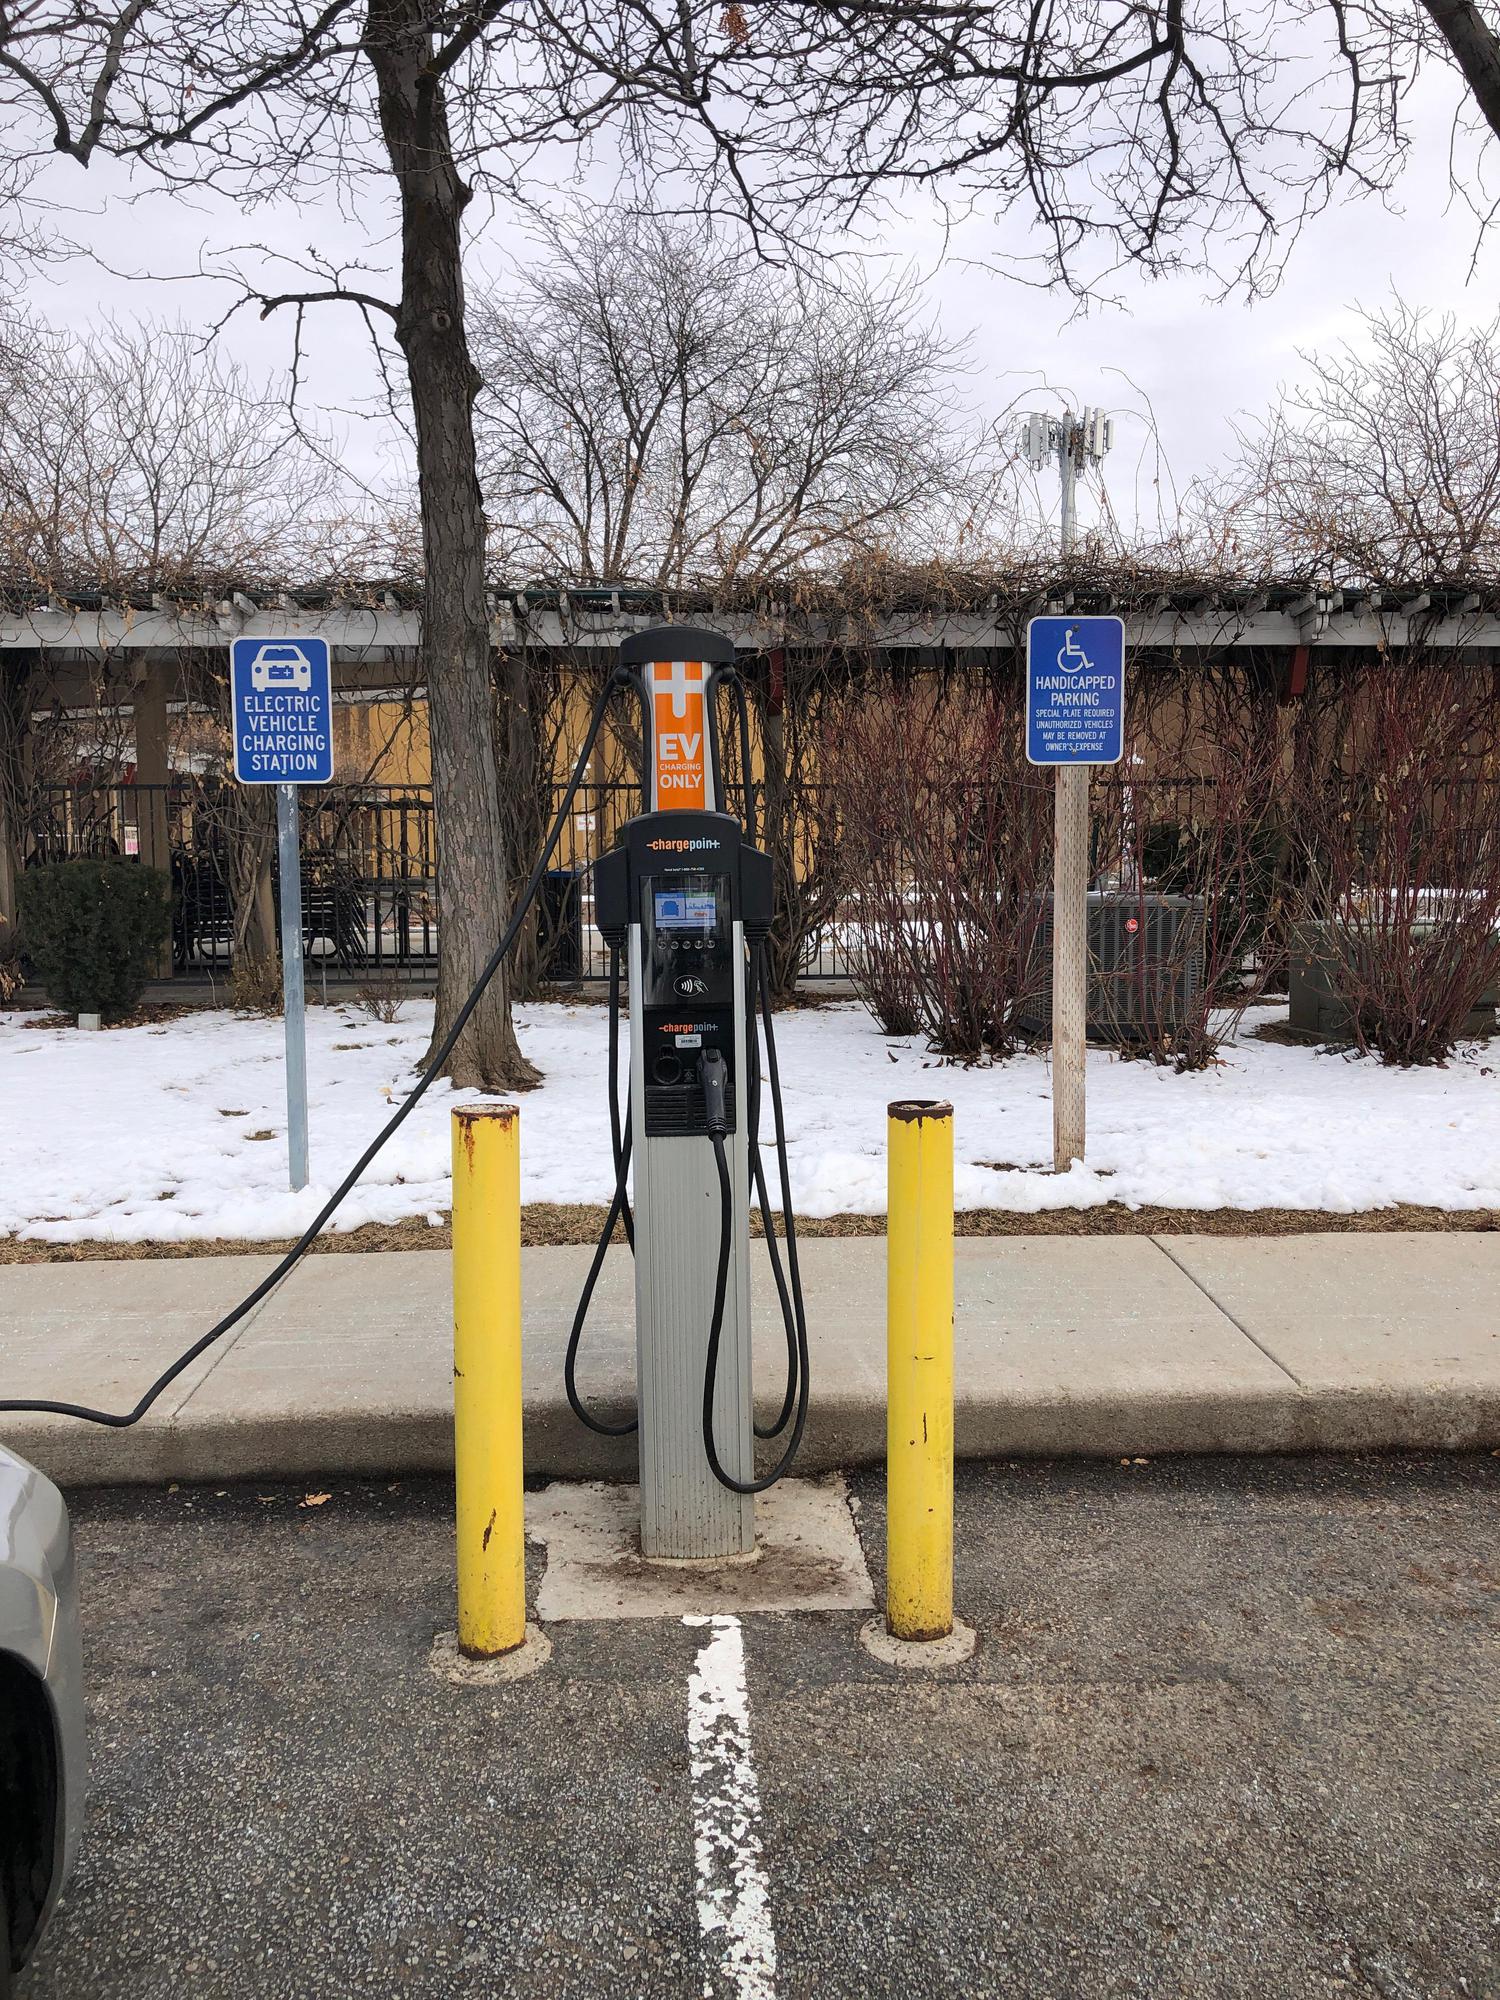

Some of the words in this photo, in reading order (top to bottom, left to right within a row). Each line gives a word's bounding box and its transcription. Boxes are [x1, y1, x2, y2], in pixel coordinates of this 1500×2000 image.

[1036, 675, 1115, 690] HANDICAPPED
[244, 696, 321, 713] ELECTRIC
[1051, 692, 1100, 706] PARKING
[1035, 708, 1061, 718] SPECIAL
[1062, 708, 1081, 718] PLATE
[1083, 708, 1115, 718] REQUIRED
[248, 715, 318, 732] VEHICLE
[1036, 720, 1082, 729] UNAUTHORIZED
[1084, 720, 1114, 729] VEHICLES
[242, 734, 326, 751] CHARGING
[1042, 731, 1055, 740] MAY
[1057, 731, 1066, 740] BE
[1067, 731, 1097, 740] REMOVED
[1098, 731, 1107, 740] AT
[659, 733, 702, 760] EV
[1045, 742, 1073, 751] OWNER'S
[1075, 742, 1104, 751] EXPENSE
[251, 754, 318, 771] STATION
[659, 763, 702, 771] CHARGING
[659, 773, 703, 789] ONLY
